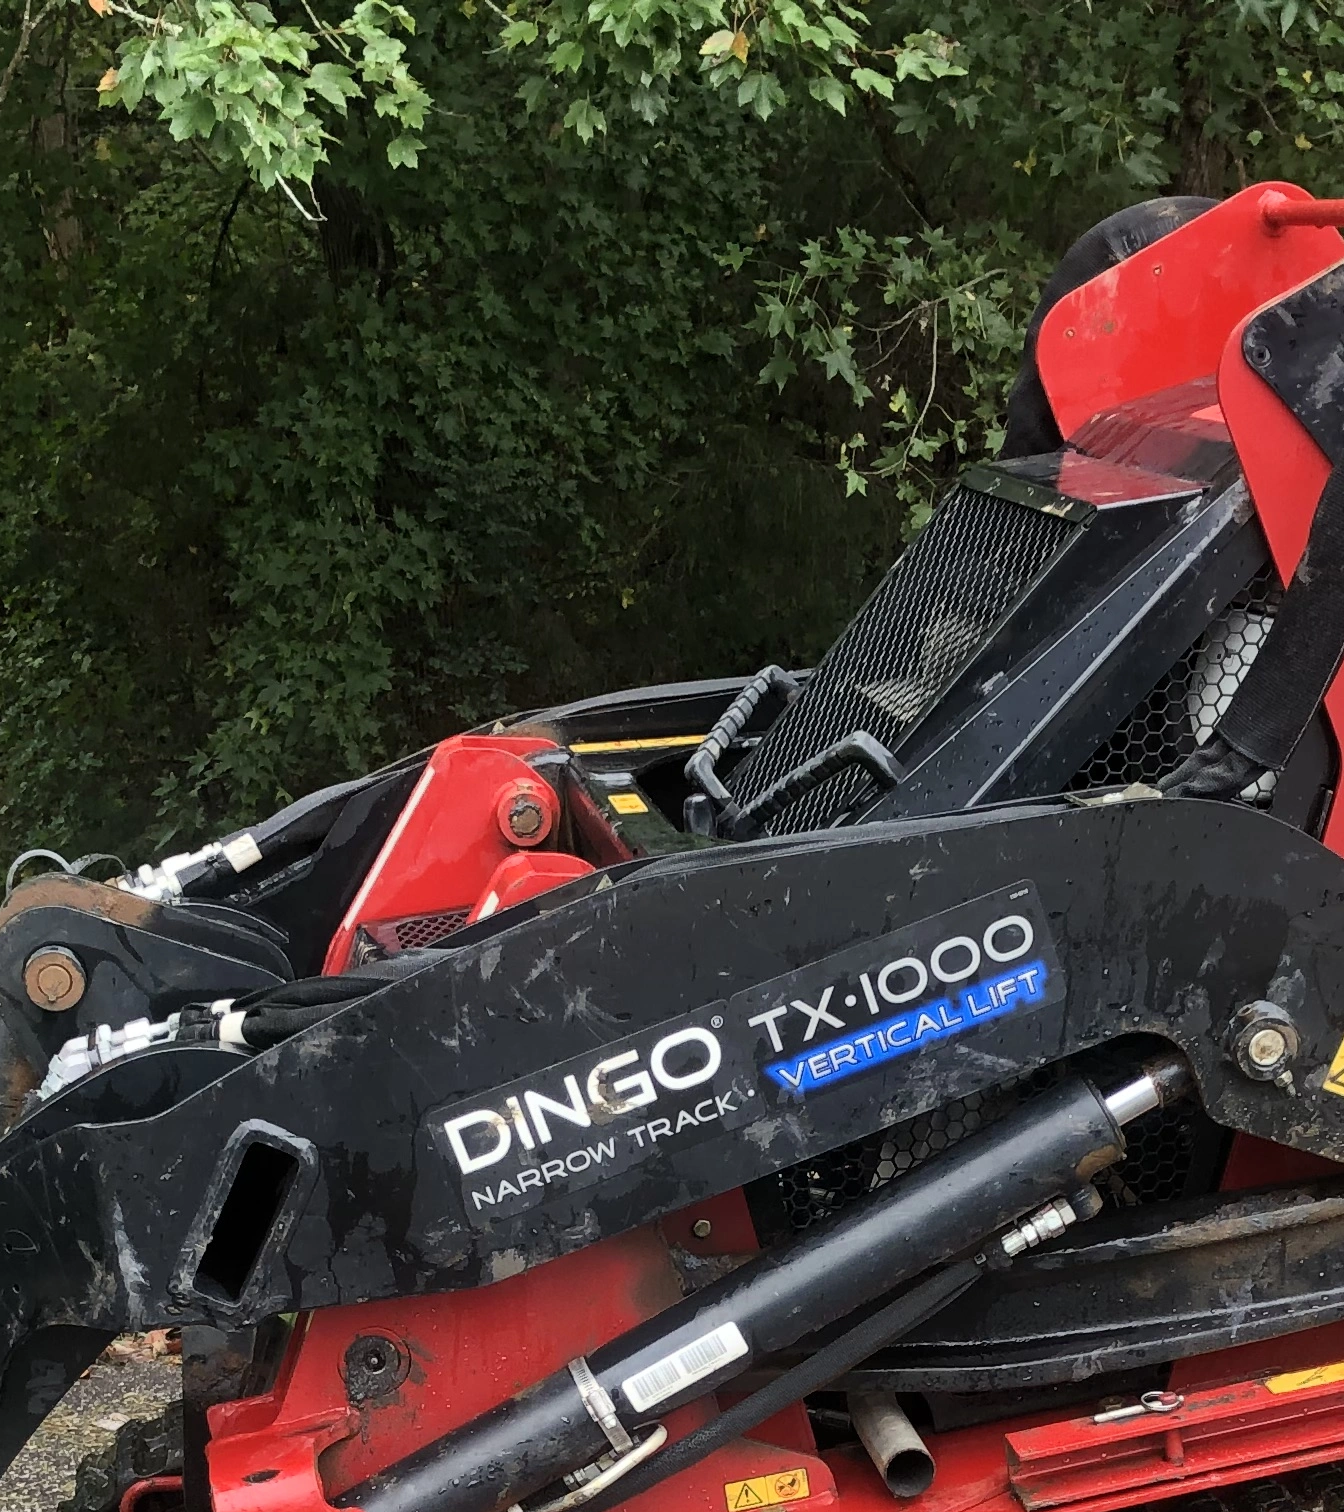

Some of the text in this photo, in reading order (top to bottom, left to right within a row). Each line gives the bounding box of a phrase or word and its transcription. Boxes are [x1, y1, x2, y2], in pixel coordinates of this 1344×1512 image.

[778, 969, 1039, 1087] VERTICAL LIFT
[472, 1090, 738, 1211] NARROW TRACK
